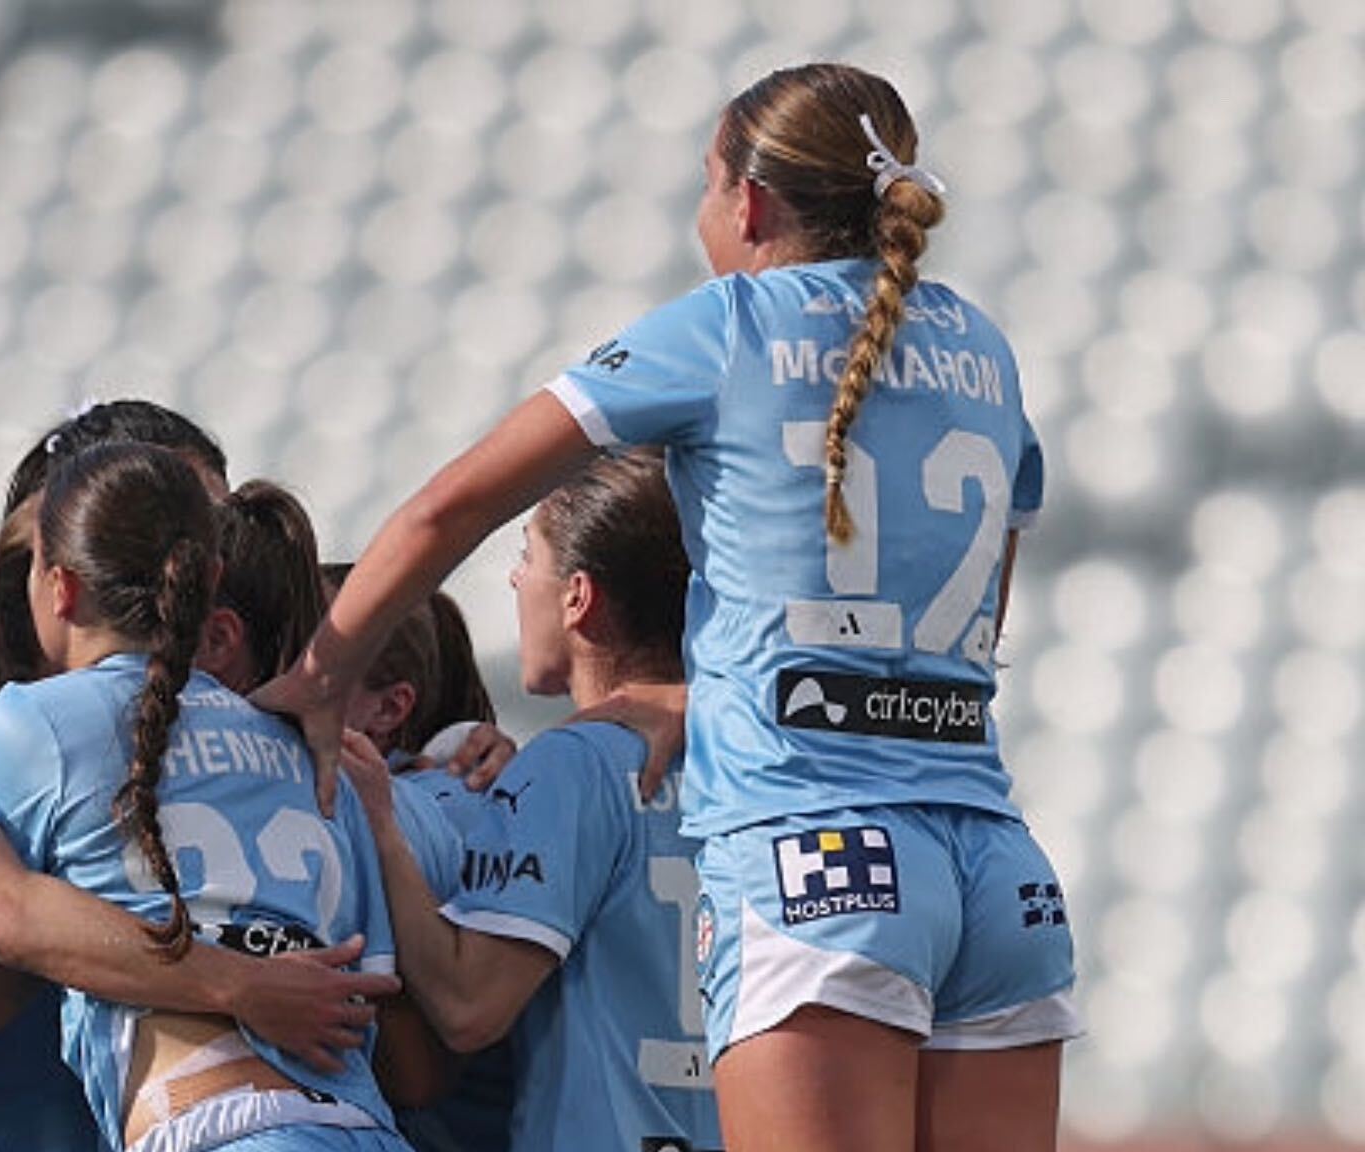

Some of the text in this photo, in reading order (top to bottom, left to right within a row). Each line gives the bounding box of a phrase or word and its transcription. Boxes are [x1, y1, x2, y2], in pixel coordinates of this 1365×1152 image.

[782, 421, 1009, 662] 12
[164, 731, 302, 784] HENRY
[785, 892, 896, 922] HOSTPLUS
